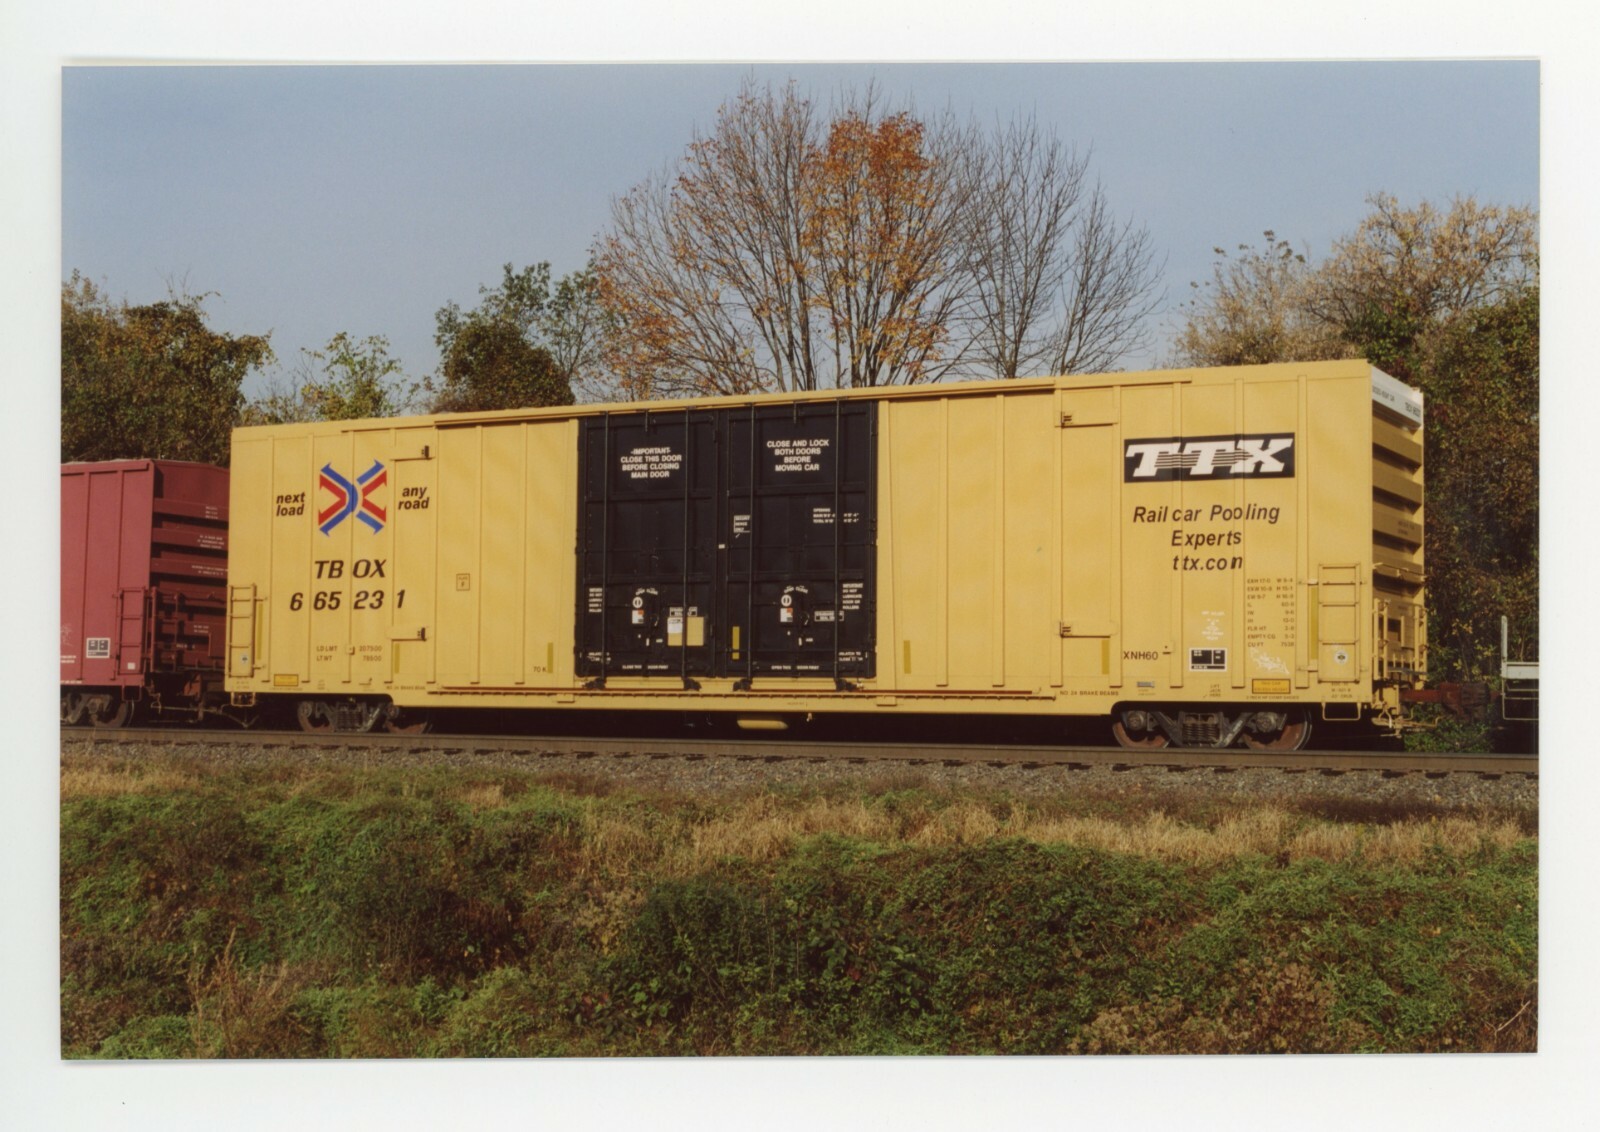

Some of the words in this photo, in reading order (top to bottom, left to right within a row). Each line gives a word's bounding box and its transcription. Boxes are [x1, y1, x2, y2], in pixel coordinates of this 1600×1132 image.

[766, 440, 790, 448] CLOSE
[809, 439, 829, 447] LOCK
[774, 448, 794, 456] BOTH
[795, 447, 821, 455] DOORS
[620, 456, 643, 464] CLOSE
[661, 454, 682, 462] DOOR
[1125, 437, 1294, 478] TTX
[622, 463, 648, 471] BEFORE
[649, 462, 679, 470] CLOSING
[775, 463, 802, 472] MOVING
[804, 463, 820, 471] CAR
[649, 470, 670, 478] DOOR
[276, 492, 305, 504] next
[402, 487, 427, 500] any
[398, 497, 430, 510] road
[276, 504, 304, 517] load
[1209, 503, 1280, 525] Pooling
[1171, 530, 1242, 550] Experts
[1123, 651, 1159, 660] XNH60
